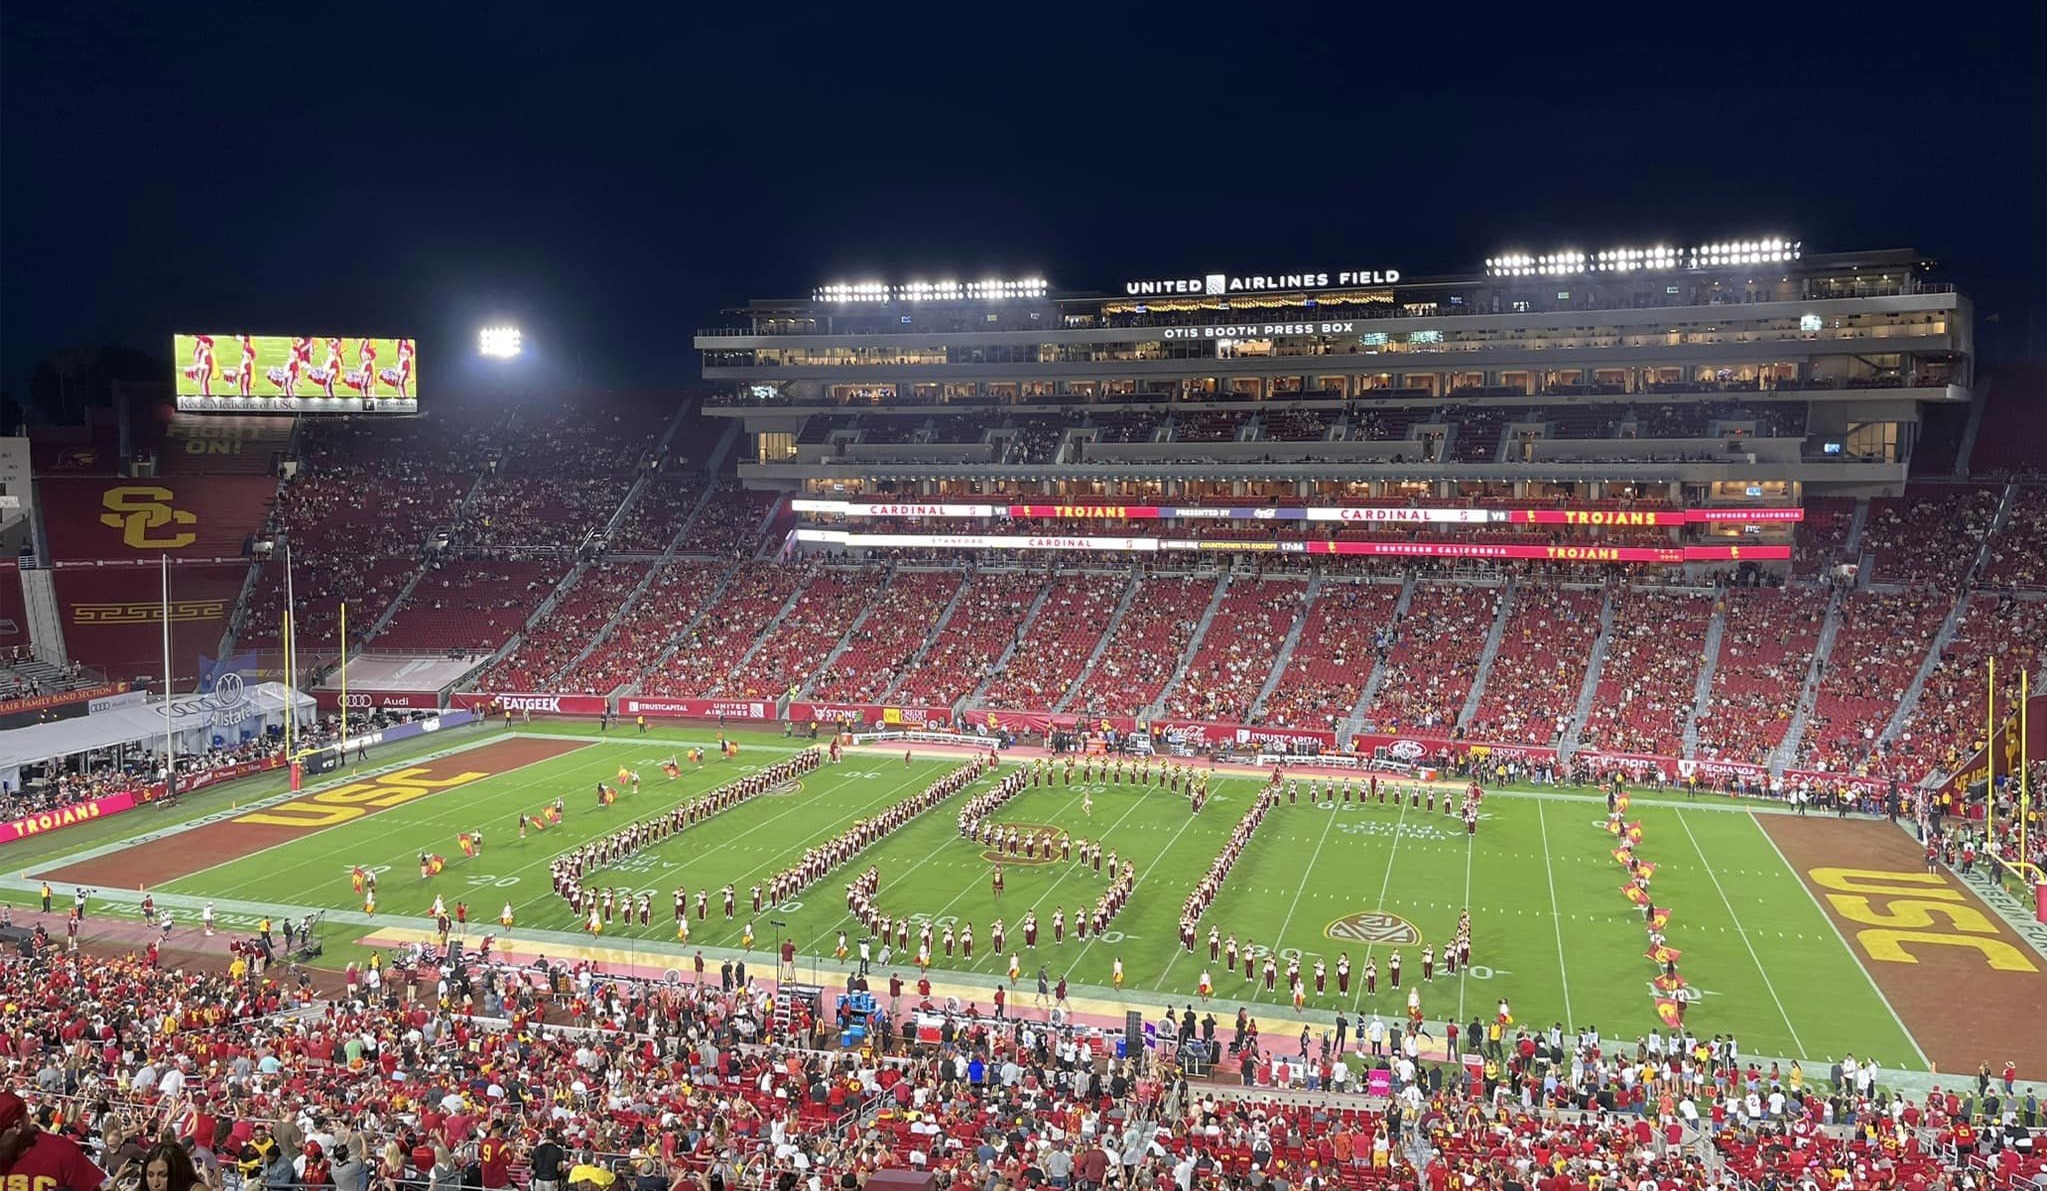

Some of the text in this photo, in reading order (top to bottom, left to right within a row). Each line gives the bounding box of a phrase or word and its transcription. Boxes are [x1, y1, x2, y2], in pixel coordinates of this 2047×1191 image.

[1126, 269, 1400, 294] UNITED AIRLINES FIELD
[1164, 322, 1353, 338] OTIS BOOTH PRESS BOX
[180, 398, 206, 410] Keck
[210, 398, 257, 410] Medicine
[274, 398, 297, 410] USC
[184, 439, 242, 455] ON!
[870, 505, 946, 515] CARDINAL
[1054, 506, 1126, 518] TROJANS
[1341, 510, 1432, 520] CARDINAL
[1751, 511, 1800, 519] CALIFORNIA
[101, 486, 197, 549] SC
[1491, 512, 1506, 522] VS
[1565, 511, 1656, 525] TROJANS
[1028, 538, 1092, 547] CARDINAL
[1375, 545, 1433, 553] SOUTHERN
[1438, 546, 1507, 555] CALIFORNIA
[1548, 547, 1619, 559] TROJANS
[22, 694, 51, 708] FAMILY
[53, 690, 77, 704] BAND
[78, 685, 113, 700] SECTION
[383, 696, 409, 706] Audi
[713, 702, 748, 710] UNITED
[900, 708, 928, 716] CREDIT
[207, 704, 255, 727] Allstate
[231, 767, 490, 827] USC
[13, 802, 100, 837] TROJANS
[466, 874, 521, 887] 20
[910, 912, 958, 926] 50
[1808, 866, 2040, 973] USC
[483, 1143, 492, 1162] 9
[0, 1173, 58, 1191] SC
